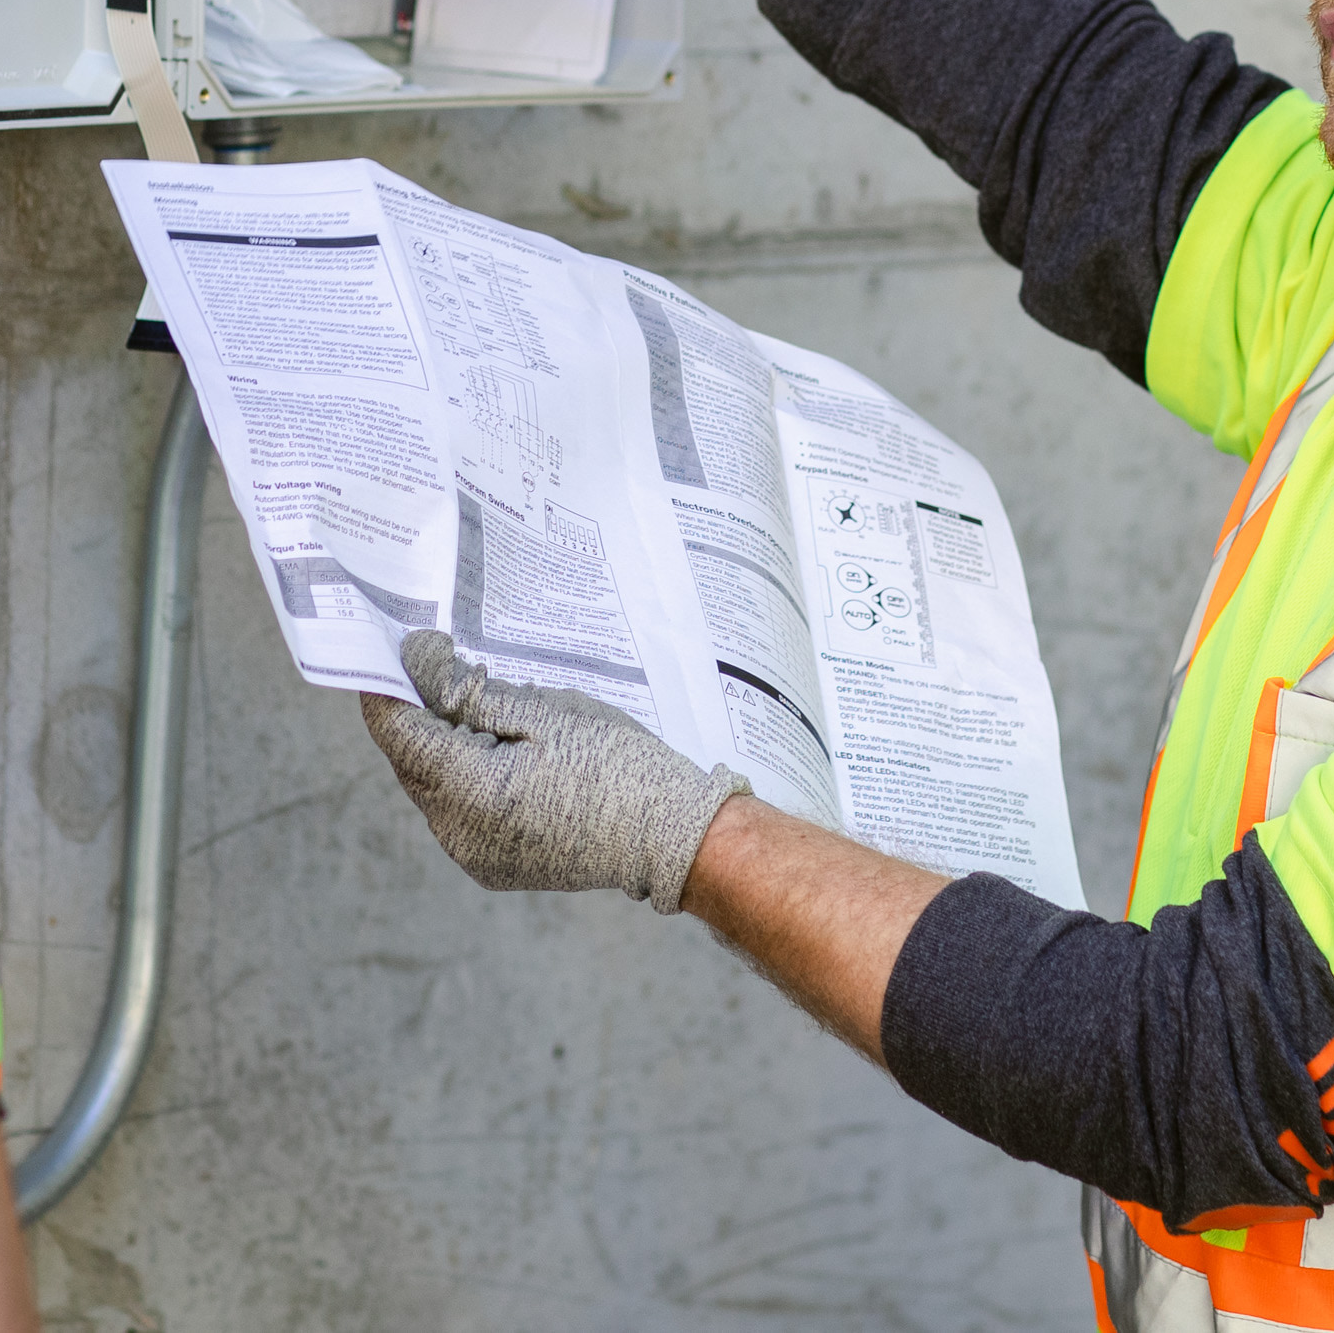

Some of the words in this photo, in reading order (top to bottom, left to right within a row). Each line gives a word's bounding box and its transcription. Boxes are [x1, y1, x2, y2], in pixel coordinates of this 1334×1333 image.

[248, 237, 297, 246] WARNING
[623, 269, 667, 298] Protective
[227, 375, 257, 385] Wiring
[657, 436, 688, 451] Overload
[251, 458, 264, 466] and
[281, 459, 308, 467] control
[311, 461, 334, 469] power
[344, 467, 368, 478] tapped
[382, 477, 417, 494] schematic.
[260, 449, 296, 458] insulation
[332, 456, 352, 465] Verify
[354, 461, 380, 471] voltage
[382, 467, 398, 478] input
[400, 473, 427, 486] matches
[430, 481, 445, 491] label
[795, 463, 828, 475] Keypad
[830, 469, 869, 483] Interface
[253, 481, 271, 490] Low
[275, 481, 311, 489] Voltage
[315, 481, 341, 496] Wiring
[455, 470, 487, 498] Program
[489, 493, 525, 522] Switches
[254, 495, 300, 503] Automation
[303, 494, 327, 504] system
[328, 499, 349, 511] control
[351, 506, 368, 518] wiring
[371, 514, 390, 527] should
[392, 521, 400, 529] be
[401, 525, 412, 534] run
[671, 498, 725, 517] Electronic
[262, 504, 297, 514] separate
[328, 508, 338, 519] The
[339, 514, 360, 527] control
[362, 521, 389, 538] terminals
[391, 533, 412, 546] accept
[349, 529, 358, 538] 3.5
[298, 542, 323, 551] Table
[687, 542, 704, 551] Fault
[696, 571, 718, 583] Locked
[387, 595, 409, 608] Output
[887, 595, 905, 603] OFF
[407, 614, 432, 624] Leads
[846, 610, 871, 620] AUTO
[821, 652, 863, 666] Operation
[866, 661, 895, 672] Modes
[351, 671, 382, 681] Advanced
[836, 685, 852, 693] OFF
[835, 751, 853, 760] LED
[856, 753, 885, 763] Status
[888, 758, 931, 772] Indicators
[848, 765, 873, 773] MODE
